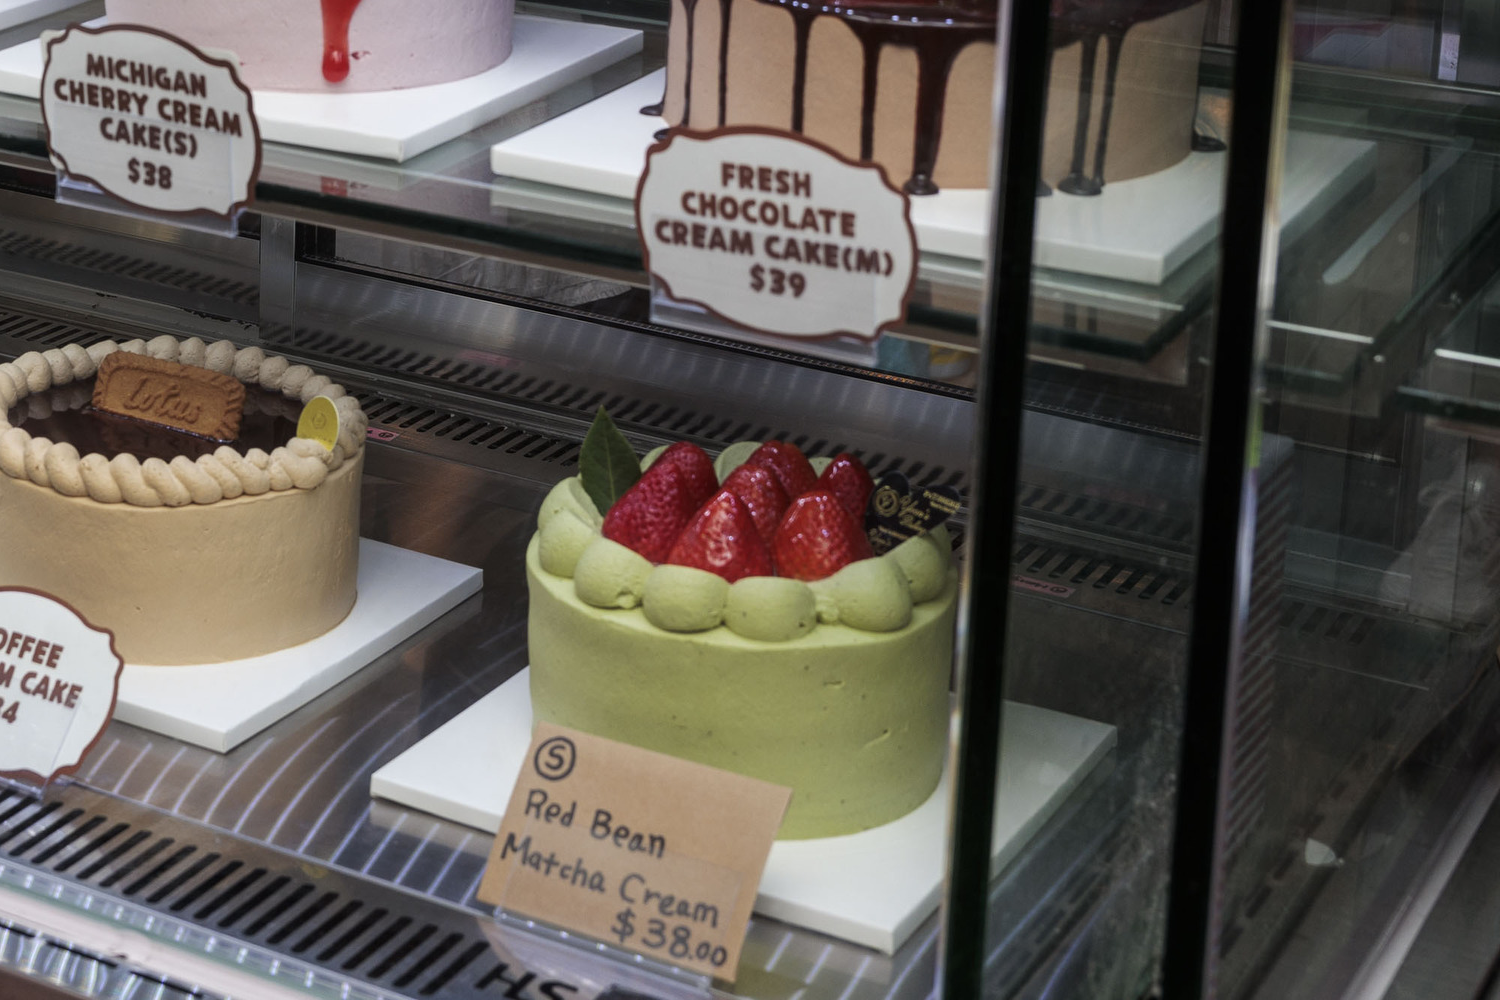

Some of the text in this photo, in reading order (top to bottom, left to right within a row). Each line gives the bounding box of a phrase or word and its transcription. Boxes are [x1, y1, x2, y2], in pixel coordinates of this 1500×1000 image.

[86, 53, 207, 98] MICHIGAN
[54, 78, 242, 138] CHERRY CREAM
[100, 117, 198, 159] CAKE(S)
[127, 157, 173, 190] $38
[721, 162, 812, 198] FRESH
[681, 190, 856, 238] CHOCOLATE
[655, 219, 894, 277] CREAM CAKE(M)
[749, 263, 806, 298] $39
[123, 376, 201, 424] Lotus
[20, 671, 83, 709] CAKE
[524, 789, 666, 858] Red Bean
[500, 833, 719, 928] Matcha Cream
[611, 907, 728, 968] $38.00
